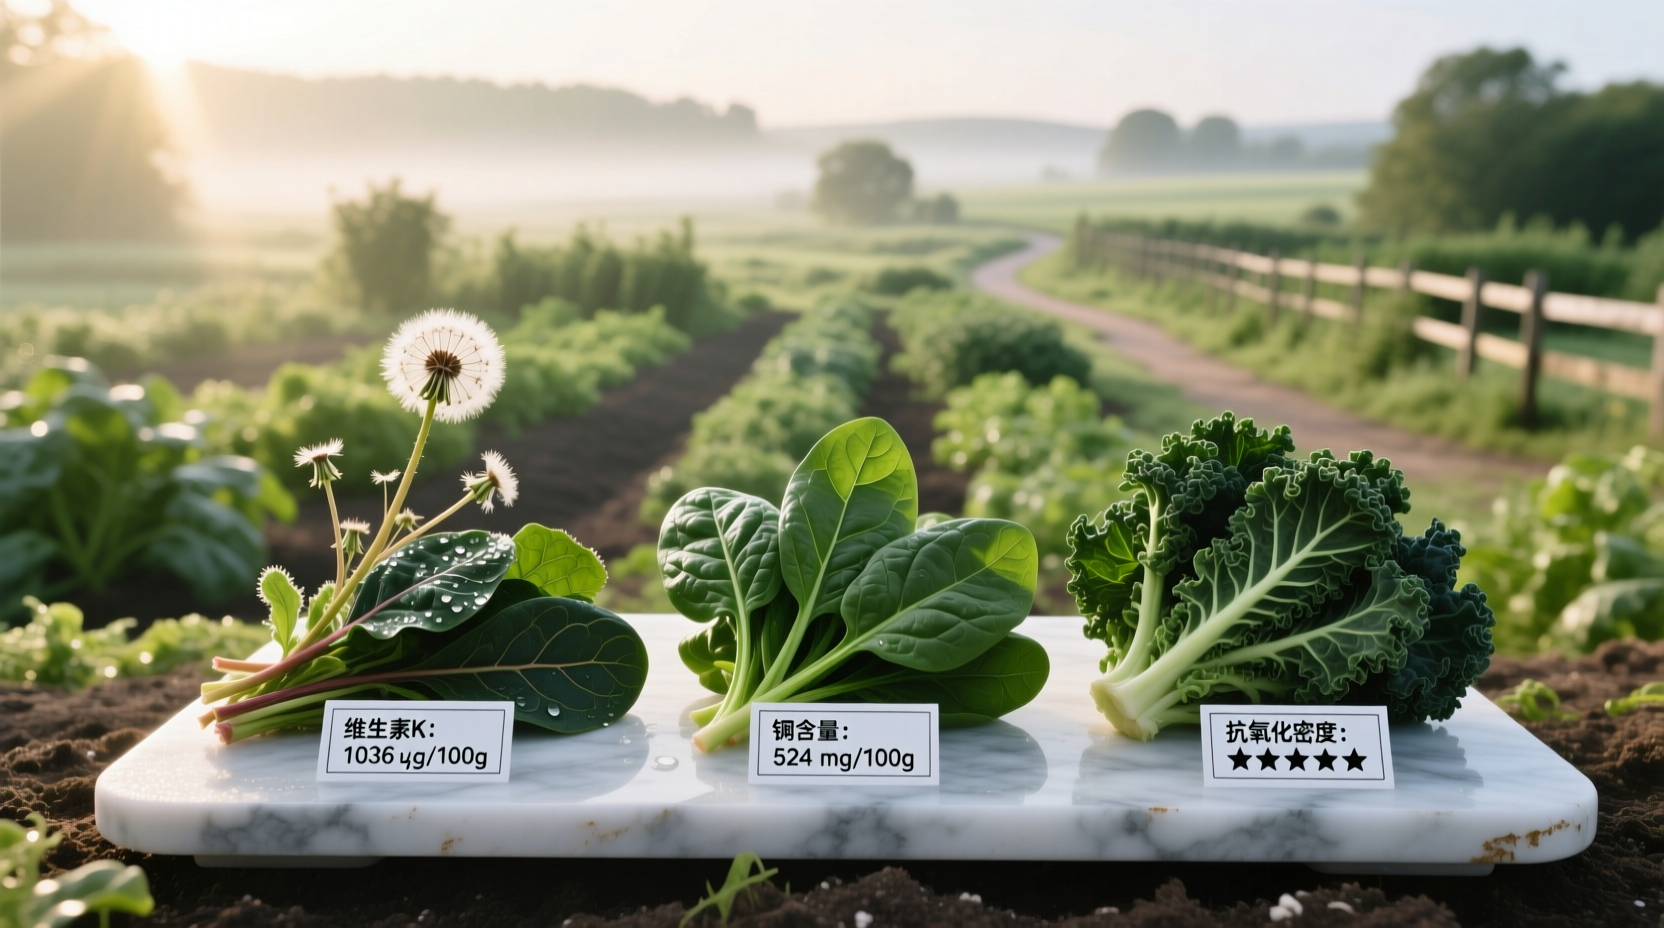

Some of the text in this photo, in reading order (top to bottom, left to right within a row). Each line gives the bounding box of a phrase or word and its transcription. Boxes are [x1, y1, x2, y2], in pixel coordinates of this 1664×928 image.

[344, 745, 395, 765] 1036
[773, 747, 914, 772] 524 mg/100g
